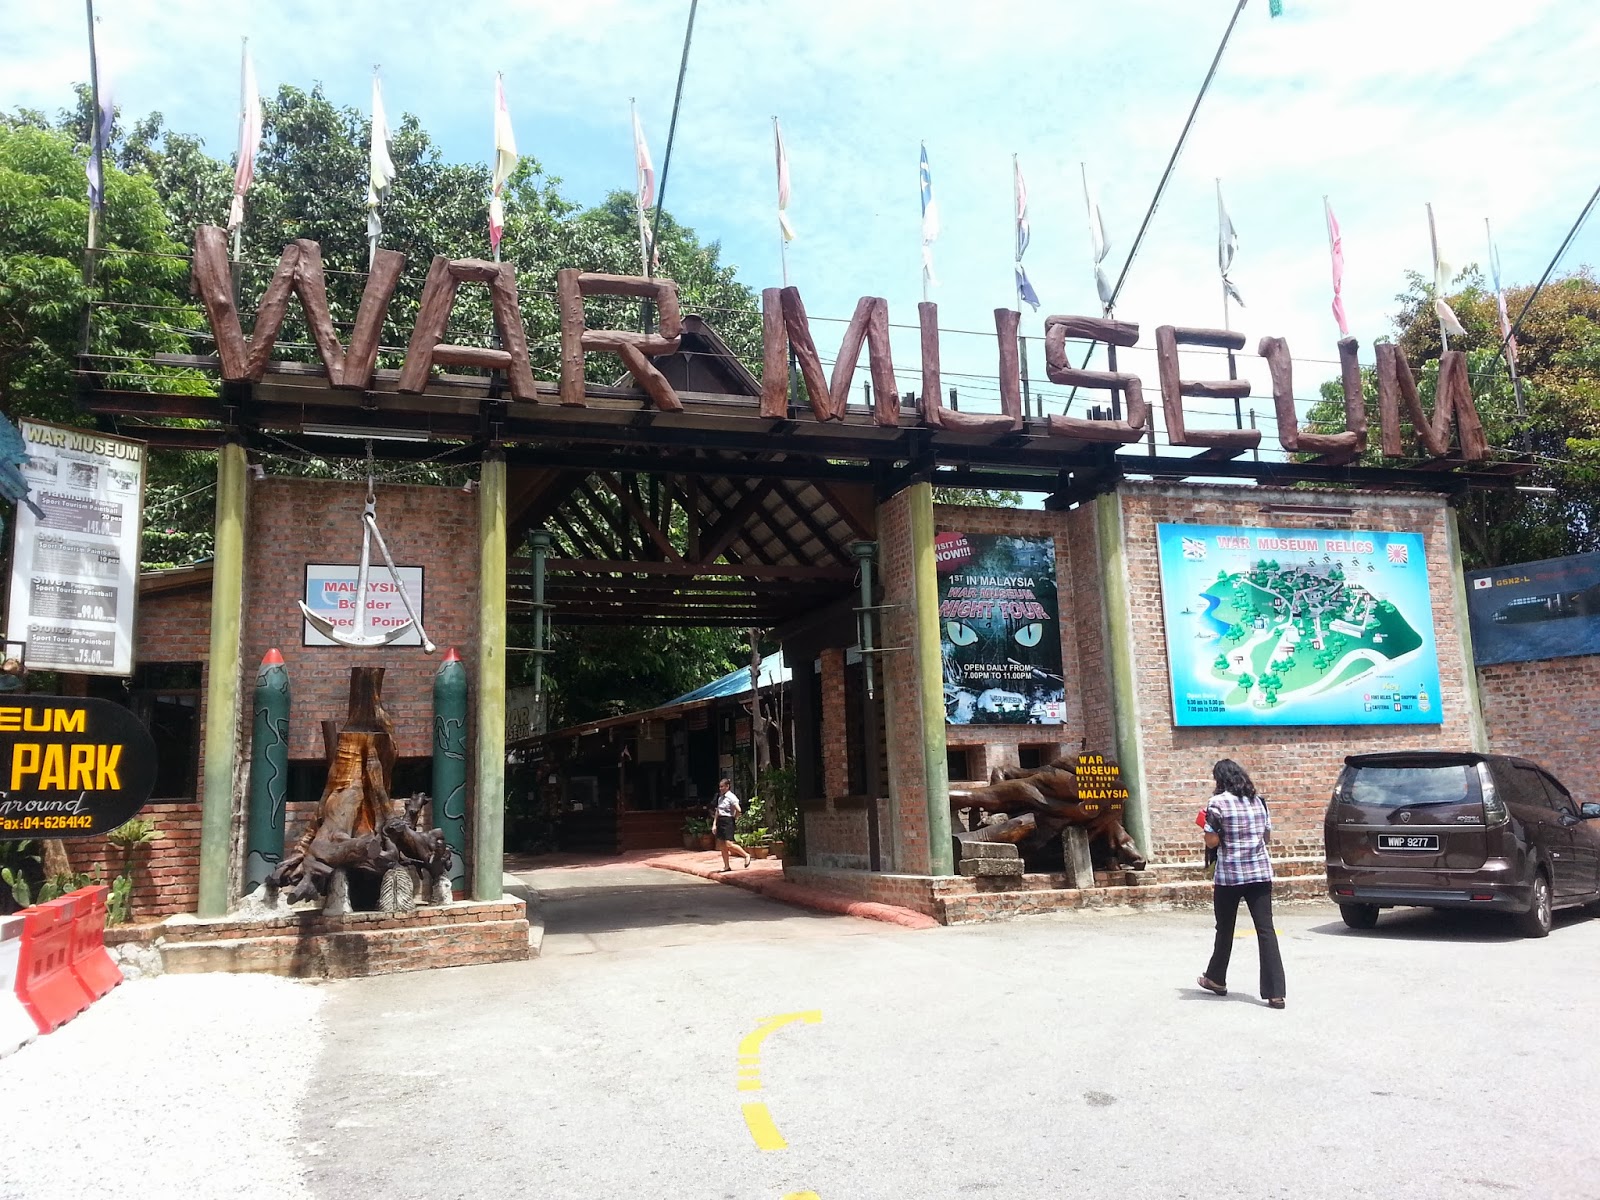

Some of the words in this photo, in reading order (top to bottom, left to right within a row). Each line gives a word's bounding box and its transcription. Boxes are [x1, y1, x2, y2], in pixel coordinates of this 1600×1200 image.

[190, 224, 685, 412] WAR
[760, 286, 1491, 461] MUSEUM
[27, 426, 66, 449] WAR
[69, 435, 140, 462] MUSEUM
[42, 497, 61, 506] Sport
[62, 500, 88, 510] Tourism
[89, 504, 118, 514] Paintball
[101, 513, 110, 521] 20
[39, 541, 58, 550] Sport
[59, 544, 86, 553] Tourism
[956, 538, 968, 547] US
[1217, 536, 1250, 549] WAR
[1257, 538, 1318, 551] MUSEUM
[1325, 540, 1374, 554] RELICS
[936, 547, 971, 562] NOW!!!
[949, 574, 964, 585] 1ST
[966, 575, 978, 586] IN
[980, 577, 1035, 588] MALAYSIA
[35, 584, 55, 592] Sport
[56, 586, 83, 595] Tourism
[83, 589, 113, 598] Paintball
[324, 582, 401, 593] MALYSI
[947, 586, 977, 599] WAR
[980, 587, 1037, 600] MUSEUM
[338, 599, 392, 610] Boder
[938, 600, 995, 619] NIGHT
[999, 601, 1052, 620] TOUR
[321, 616, 355, 627] hec
[32, 633, 51, 642] Sport
[53, 635, 80, 644] Tourism
[81, 637, 111, 646] Paintball
[963, 663, 985, 672] OPEN
[986, 664, 1008, 672] DAILY
[1009, 664, 1031, 672] FROM
[963, 672, 990, 680] 7.00PM
[991, 672, 1002, 680] TO
[1003, 672, 1032, 680] 11.00PM
[0, 707, 86, 733] EUM
[1079, 755, 1103, 764] WAR
[10, 743, 122, 791] PARK
[1075, 766, 1119, 775] MUSEUM
[1078, 789, 1129, 799] MALAYSIA
[1387, 837, 1405, 847] WWP
[1407, 837, 1429, 847] 9277
